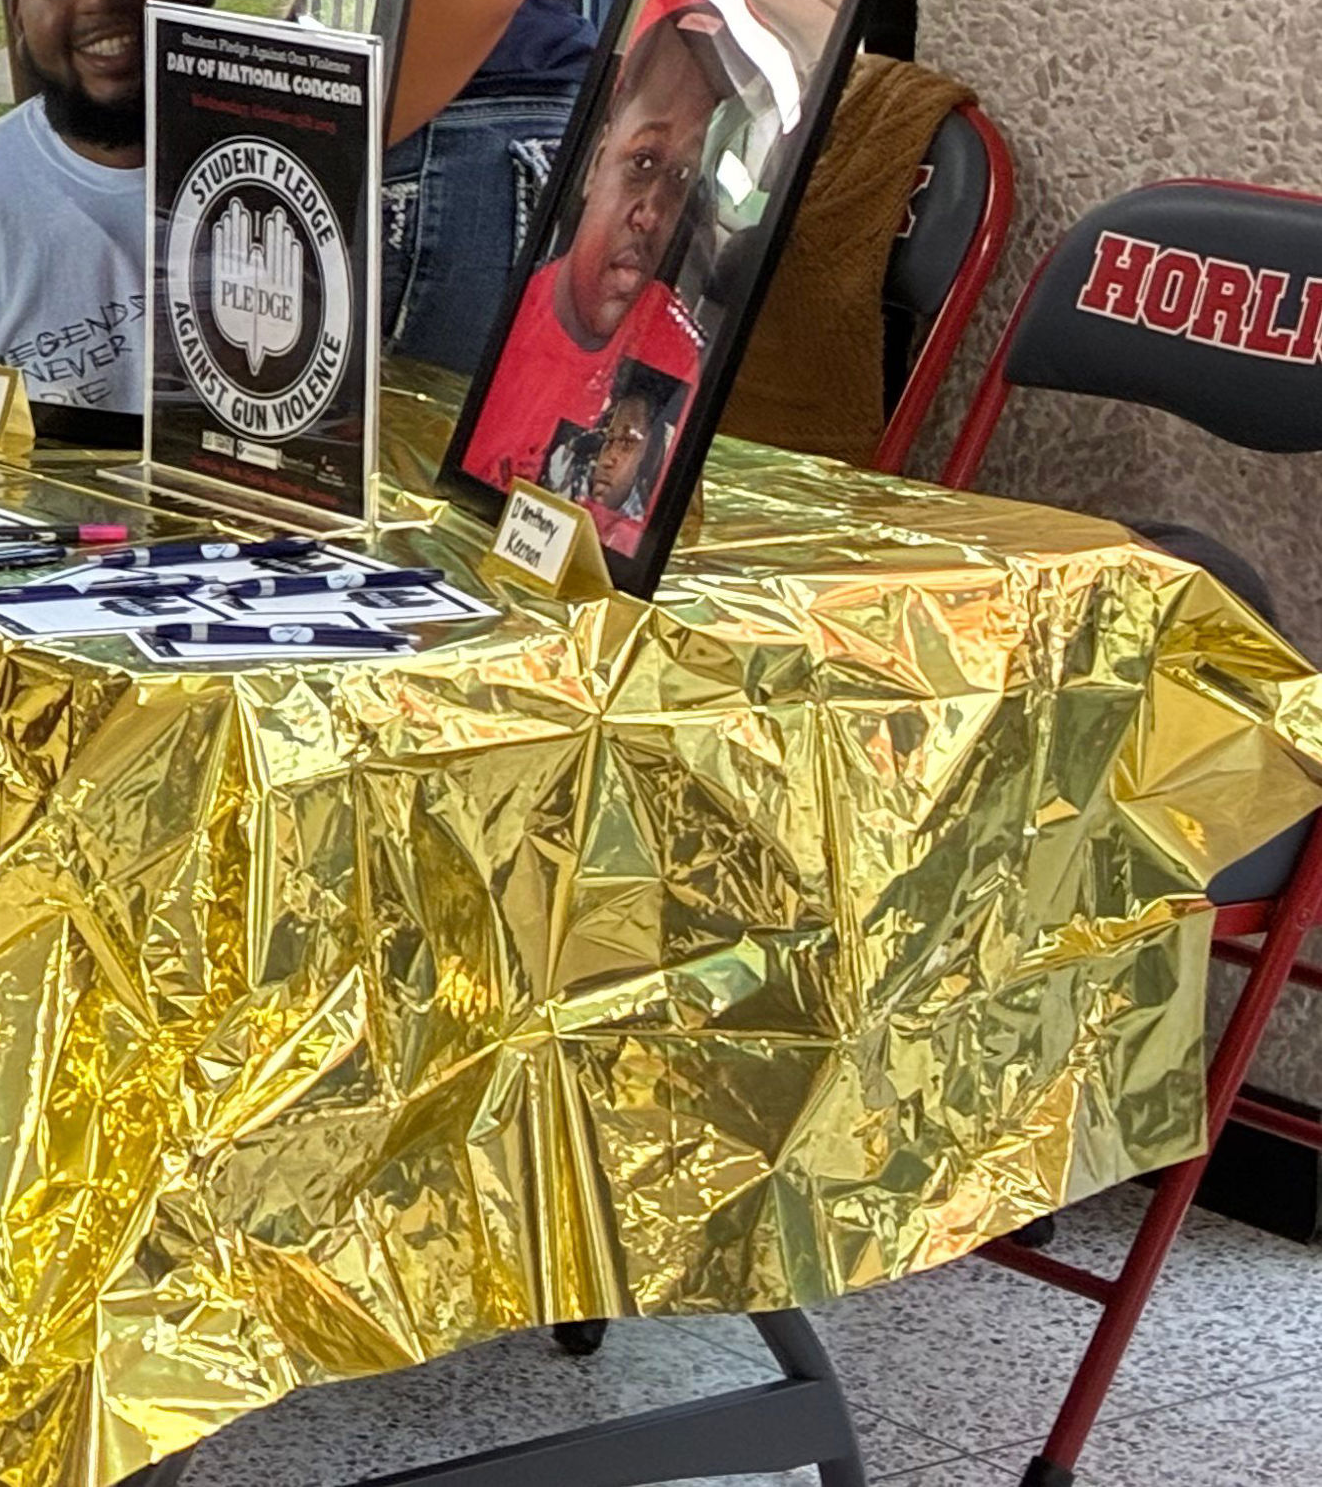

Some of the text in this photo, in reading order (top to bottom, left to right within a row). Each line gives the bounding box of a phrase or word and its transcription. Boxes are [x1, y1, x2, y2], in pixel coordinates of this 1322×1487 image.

[166, 52, 195, 75] DAY
[197, 58, 216, 79] OF
[191, 147, 336, 248] STUDENT PLEDGE
[220, 281, 293, 321] PLEDGE
[1077, 231, 1322, 365] HORLI
[173, 300, 342, 431] AGAINST GUN VIOLENCE
